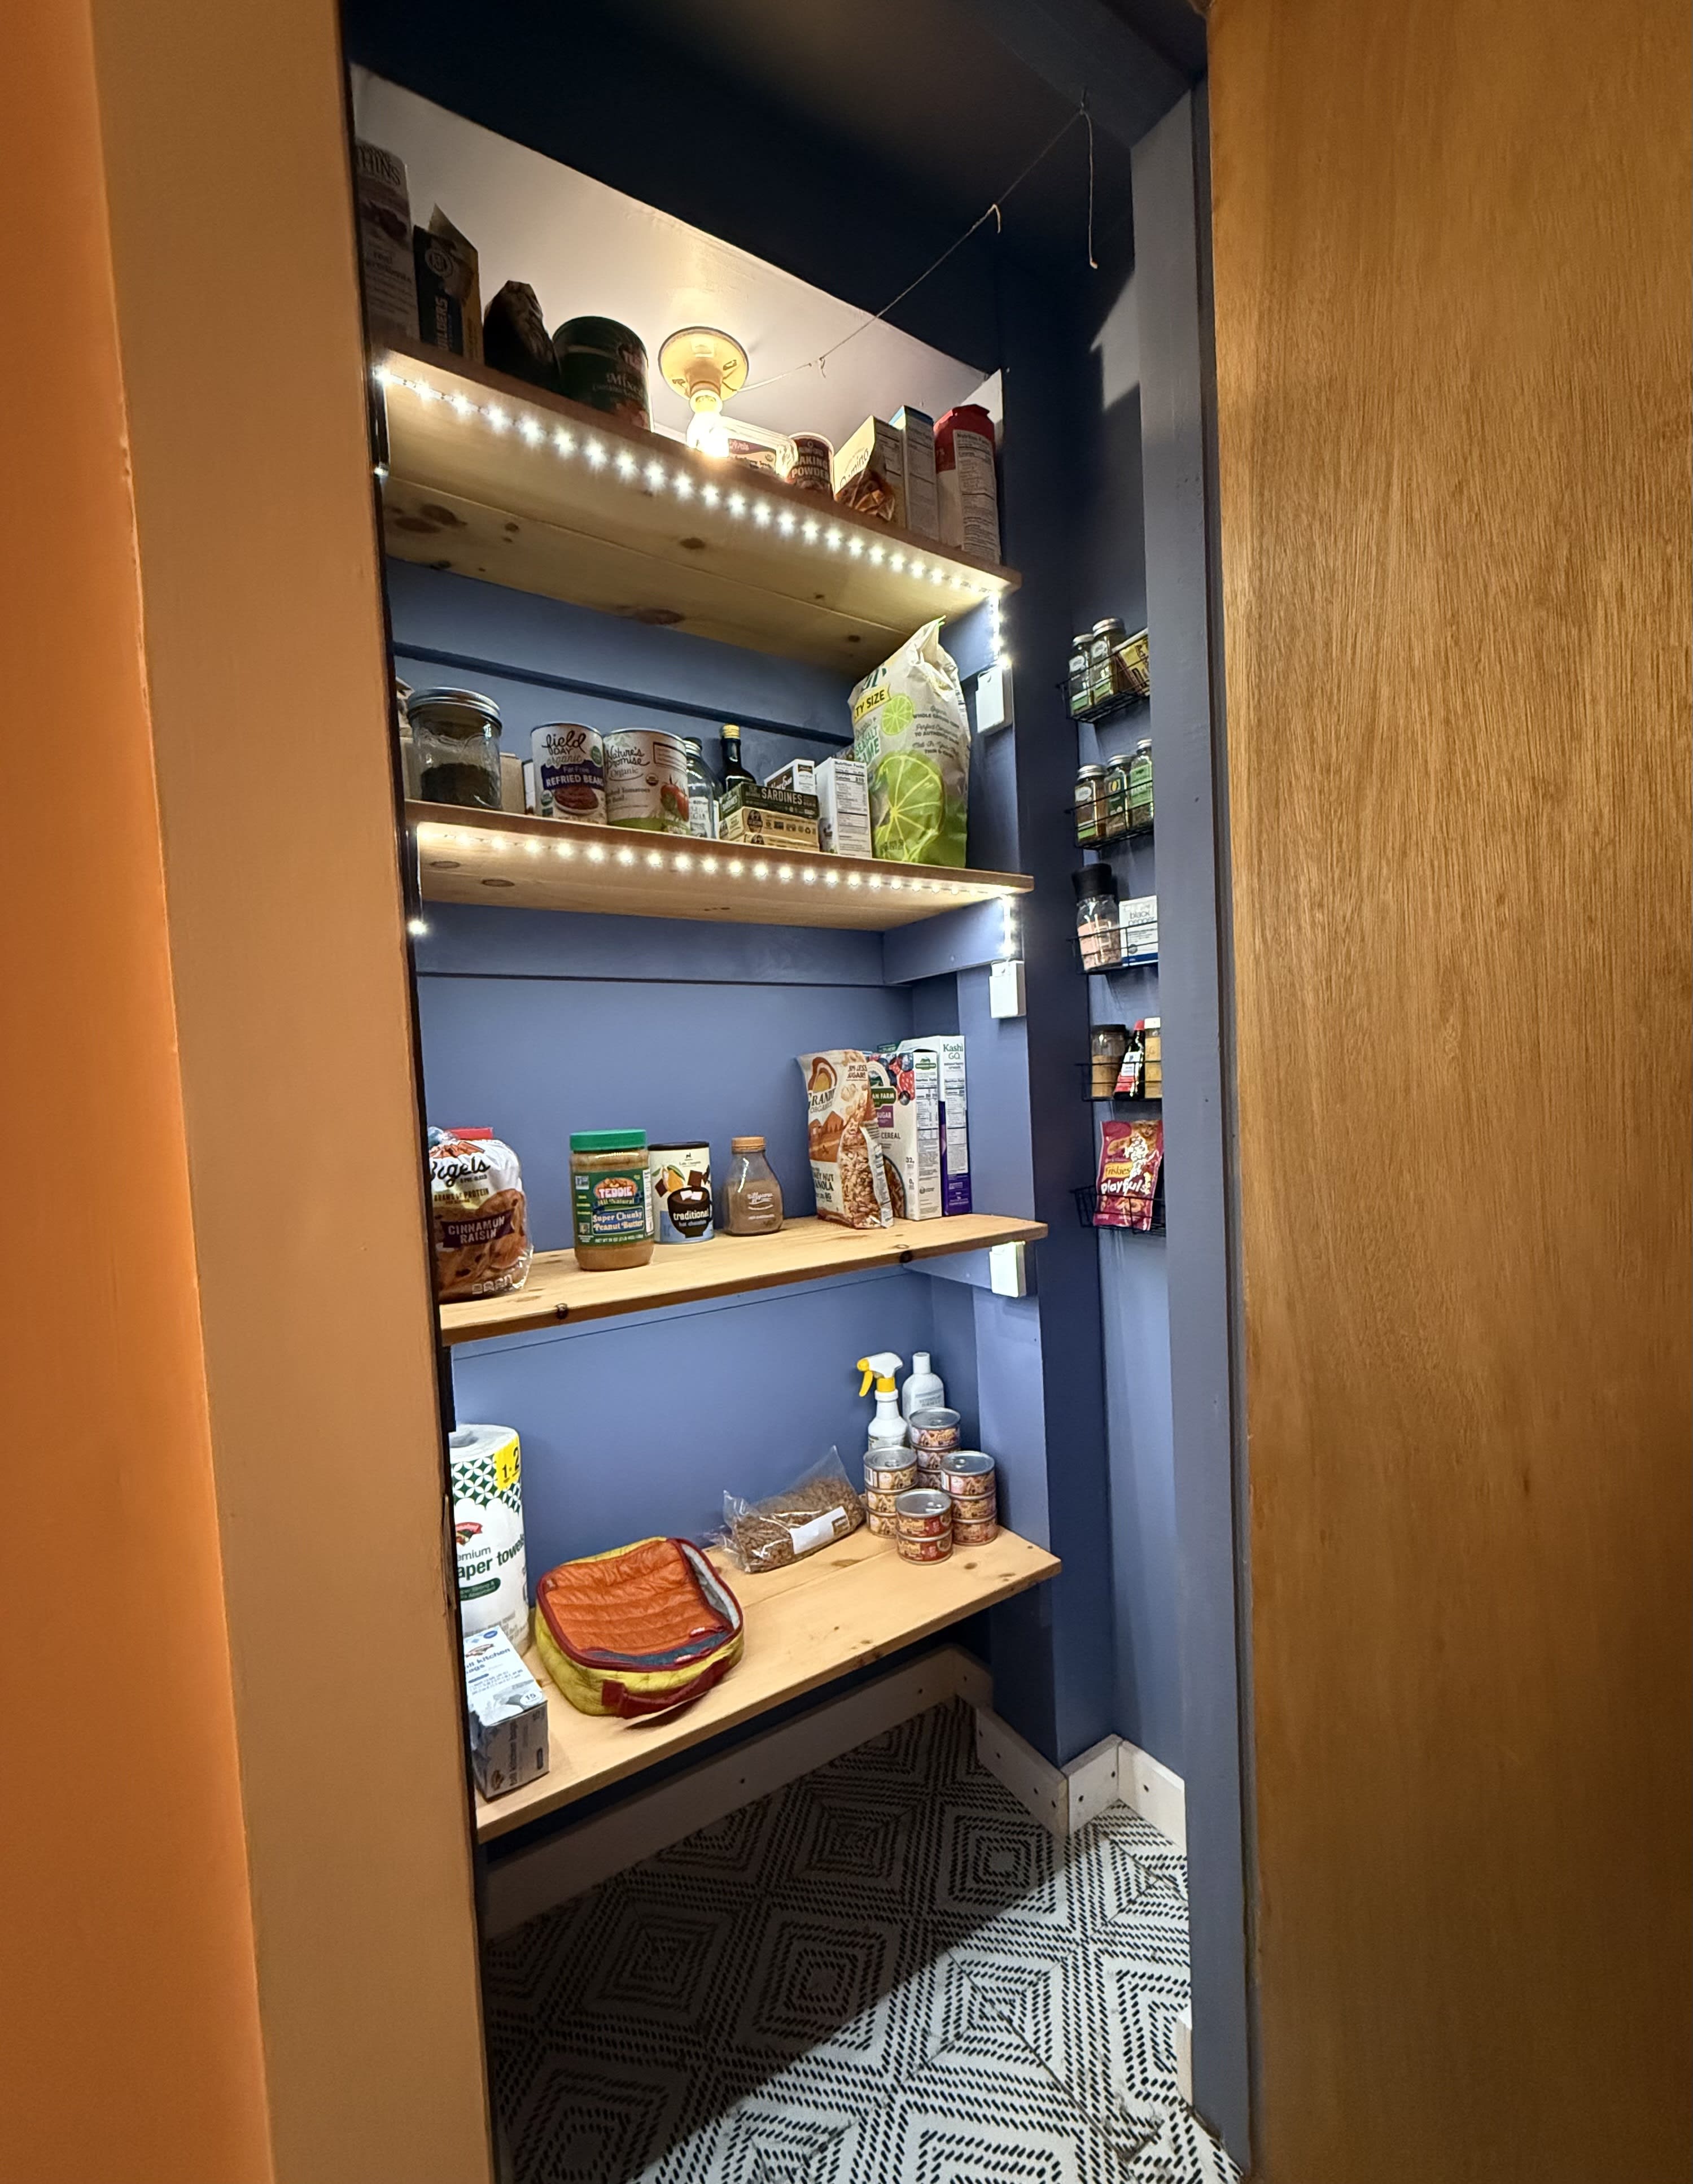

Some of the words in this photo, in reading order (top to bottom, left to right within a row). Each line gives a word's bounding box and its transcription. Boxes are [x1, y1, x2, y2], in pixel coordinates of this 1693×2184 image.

[854, 702, 864, 719] TY
[867, 689, 885, 709] SIZE
[541, 730, 587, 755] field
[606, 745, 645, 760] Nature's
[546, 774, 581, 788] REFRIED
[761, 787, 803, 806] SARDINES
[1129, 911, 1150, 920] black
[943, 1043, 964, 1052] Kashi
[1105, 1165, 1131, 1176] Friskies
[434, 1193, 455, 1202] GRAMS
[463, 1187, 489, 1199] PROTEIN
[598, 1186, 633, 1199] TEDDIE
[592, 1214, 615, 1223] Super
[616, 1210, 642, 1220] Chunky
[673, 1208, 709, 1221] traditional
[448, 1215, 505, 1235] CINNAMON
[593, 1222, 620, 1231] Peanut
[621, 1220, 644, 1229] Butter
[459, 1228, 497, 1244] RAISIN
[476, 1648, 511, 1664] kitchen
